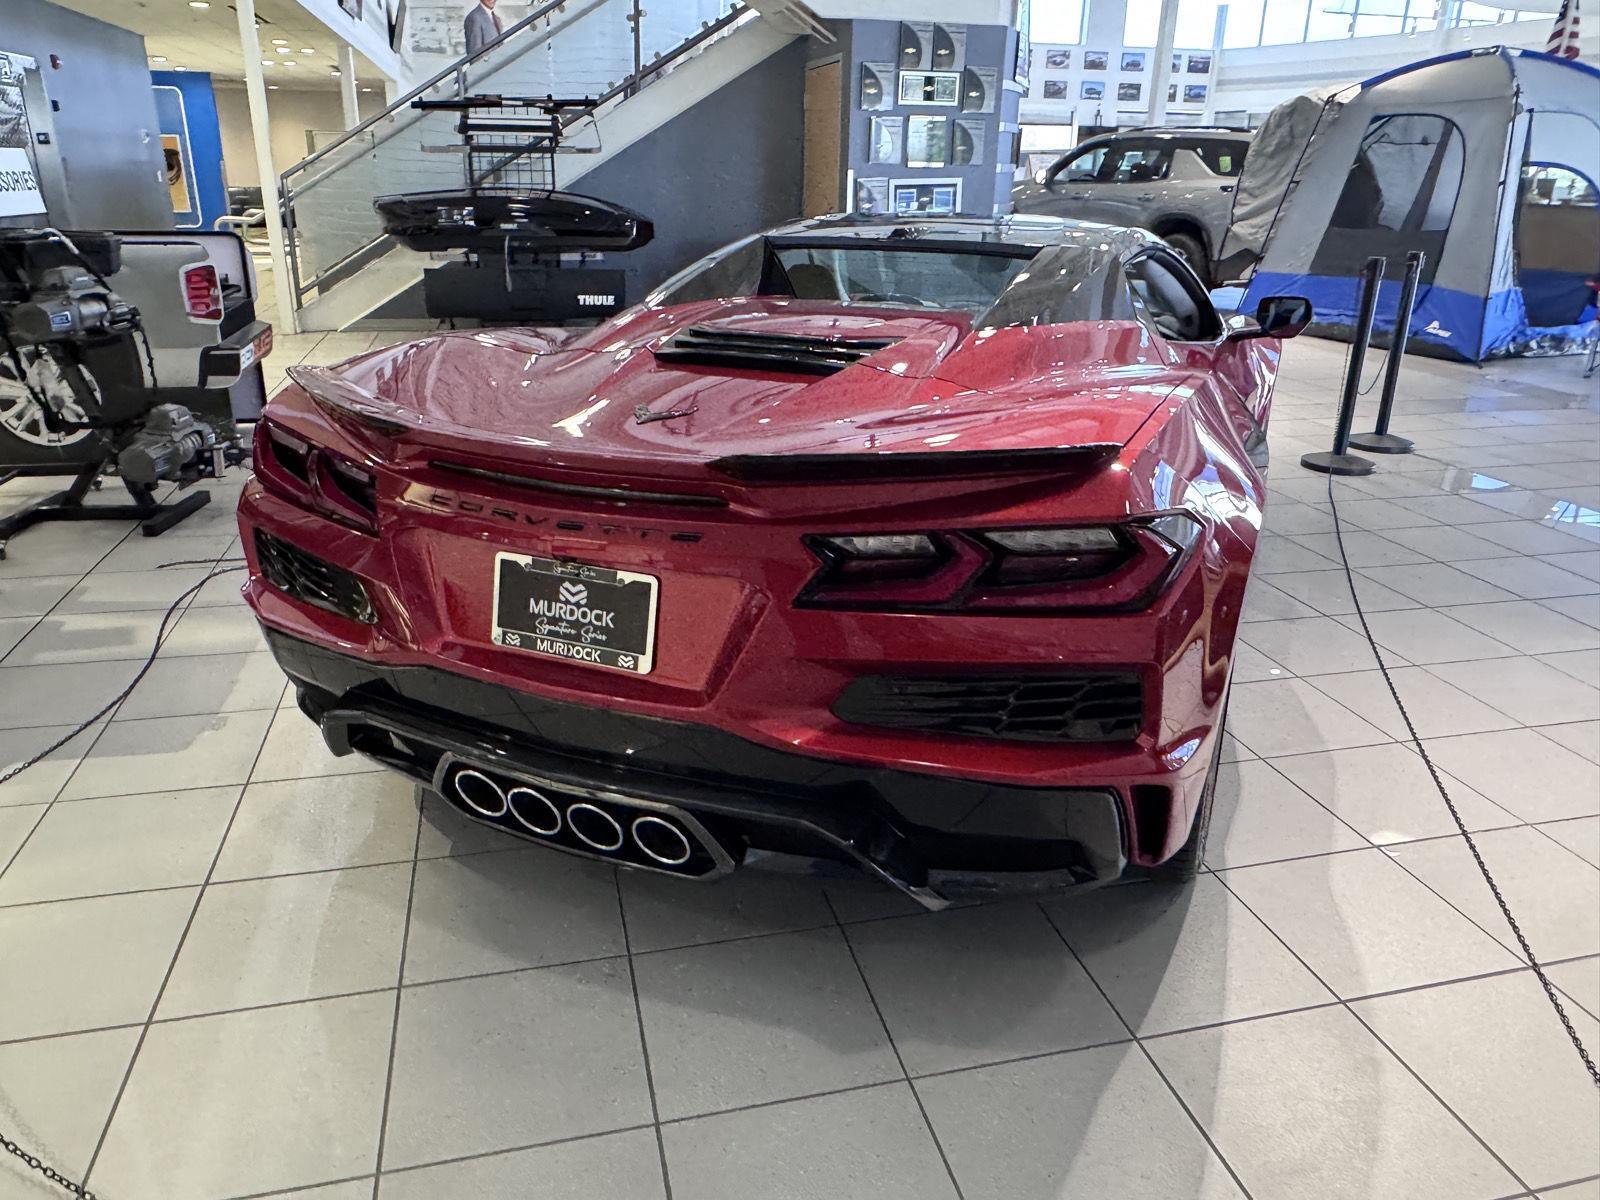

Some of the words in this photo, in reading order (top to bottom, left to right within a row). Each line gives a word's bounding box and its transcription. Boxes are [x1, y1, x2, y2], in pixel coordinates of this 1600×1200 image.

[0, 170, 37, 192] SORIES
[577, 294, 615, 306] THULE
[431, 494, 703, 543] CORVETTE
[529, 597, 615, 629] MURDOCK
[535, 616, 578, 636] Signature
[580, 625, 608, 644] Series
[536, 638, 601, 663] MURDOCK
